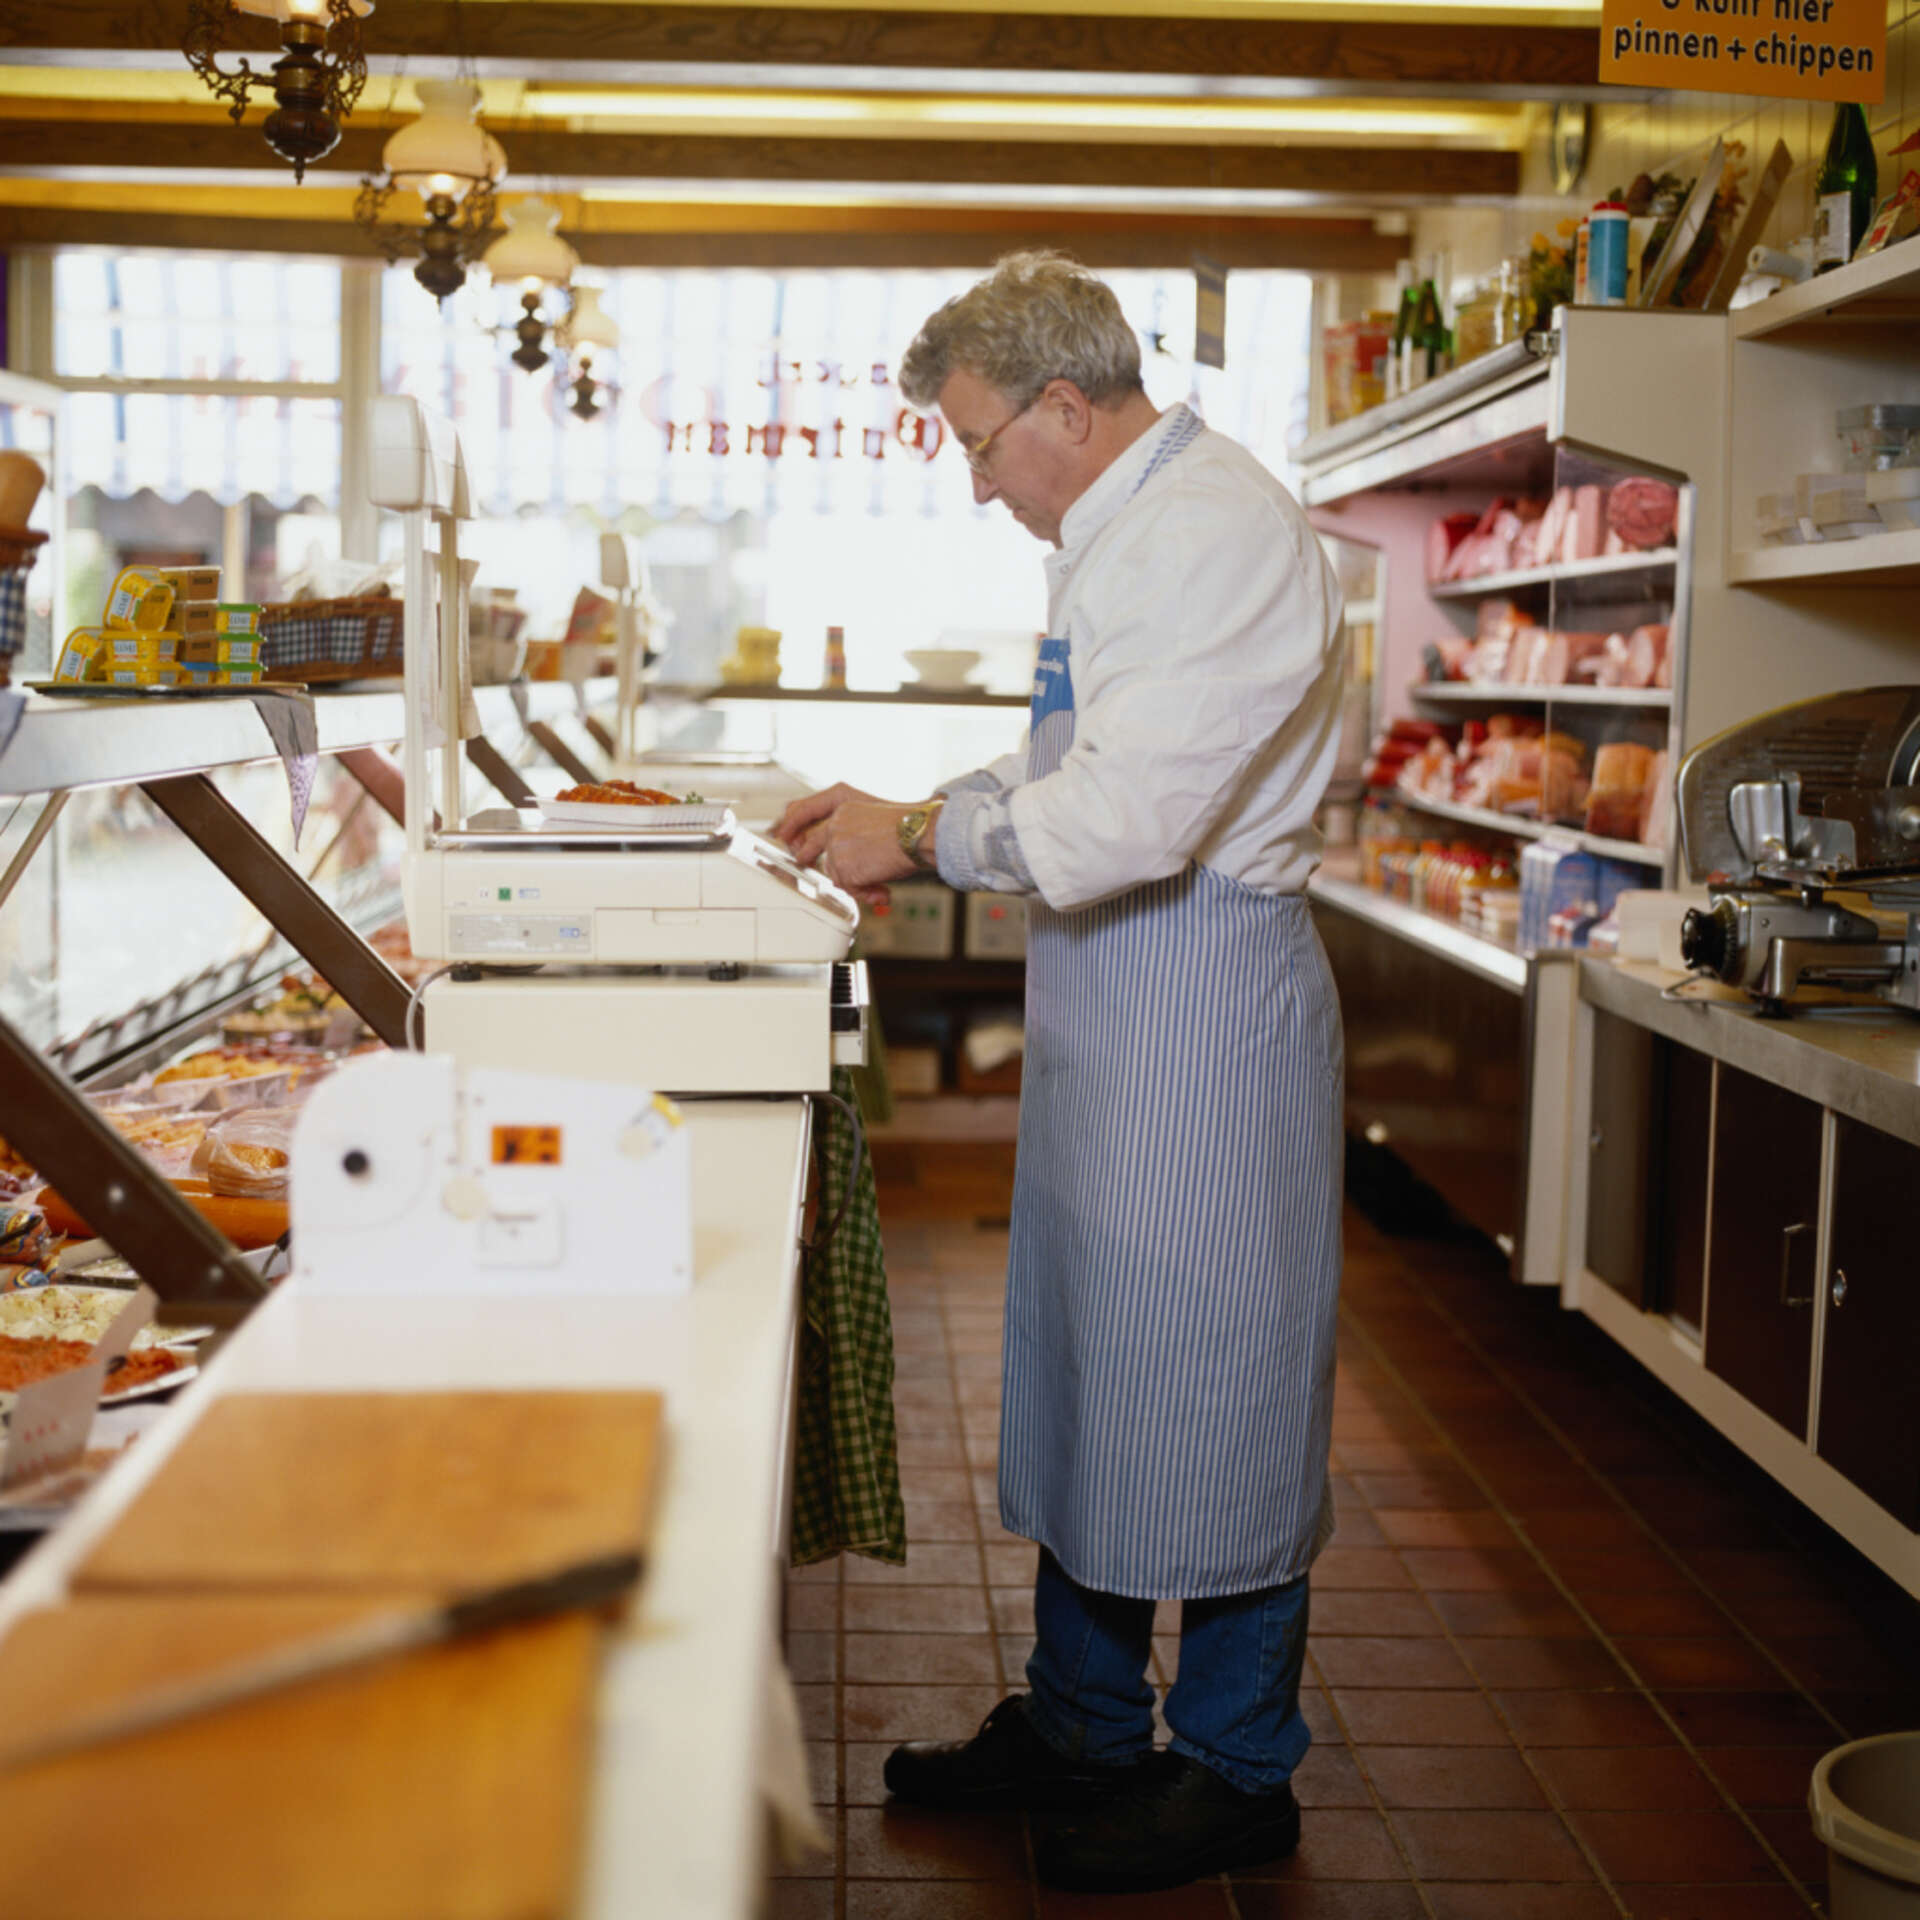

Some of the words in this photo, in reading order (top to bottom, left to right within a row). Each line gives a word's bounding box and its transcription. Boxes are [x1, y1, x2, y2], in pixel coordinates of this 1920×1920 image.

[1774, 0, 1834, 23] hier
[1614, 19, 1718, 60] pinnen
[1726, 38, 1747, 61] +
[1754, 31, 1873, 77] chippen
